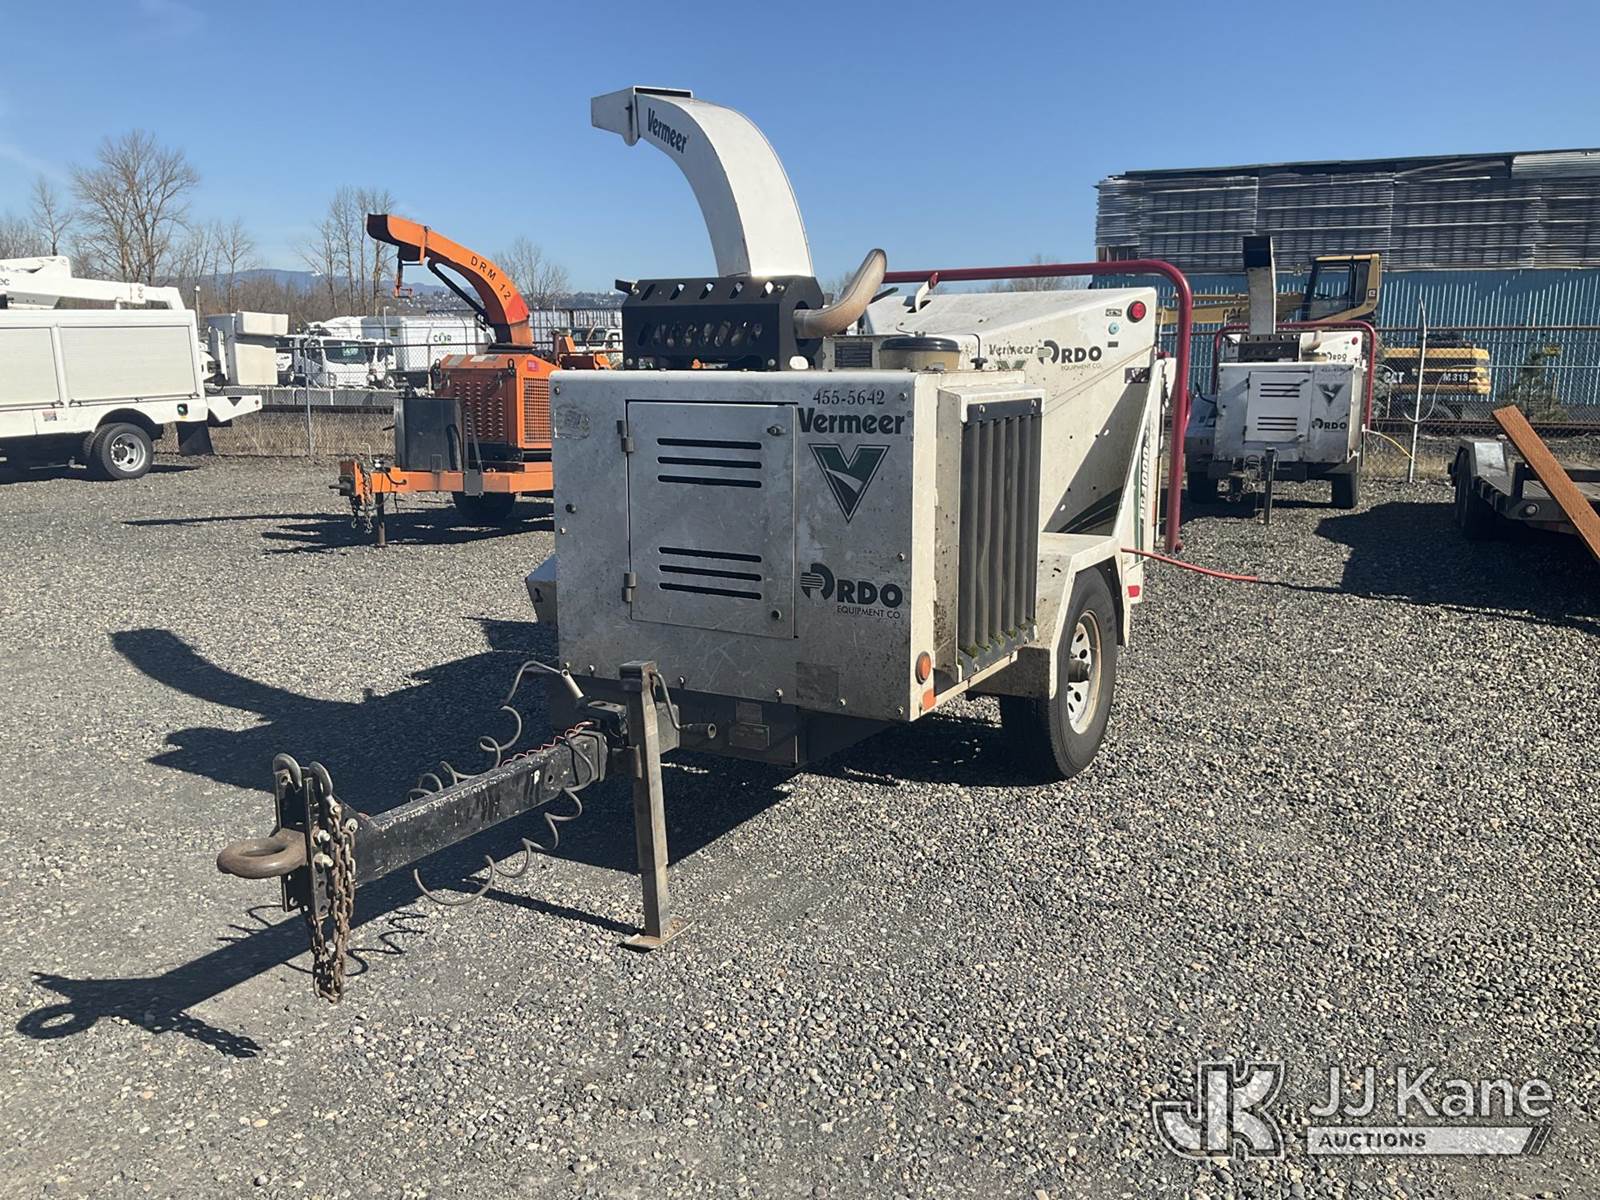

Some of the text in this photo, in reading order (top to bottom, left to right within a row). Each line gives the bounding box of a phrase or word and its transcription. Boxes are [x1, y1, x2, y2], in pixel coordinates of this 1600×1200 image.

[647, 107, 687, 154] Vermeer
[471, 255, 511, 300] DRM 12
[989, 343, 1034, 356] Vermeer
[813, 389, 885, 405] 455-5642
[798, 407, 905, 435] Vermeer
[837, 605, 884, 618] EQUIPMENT
